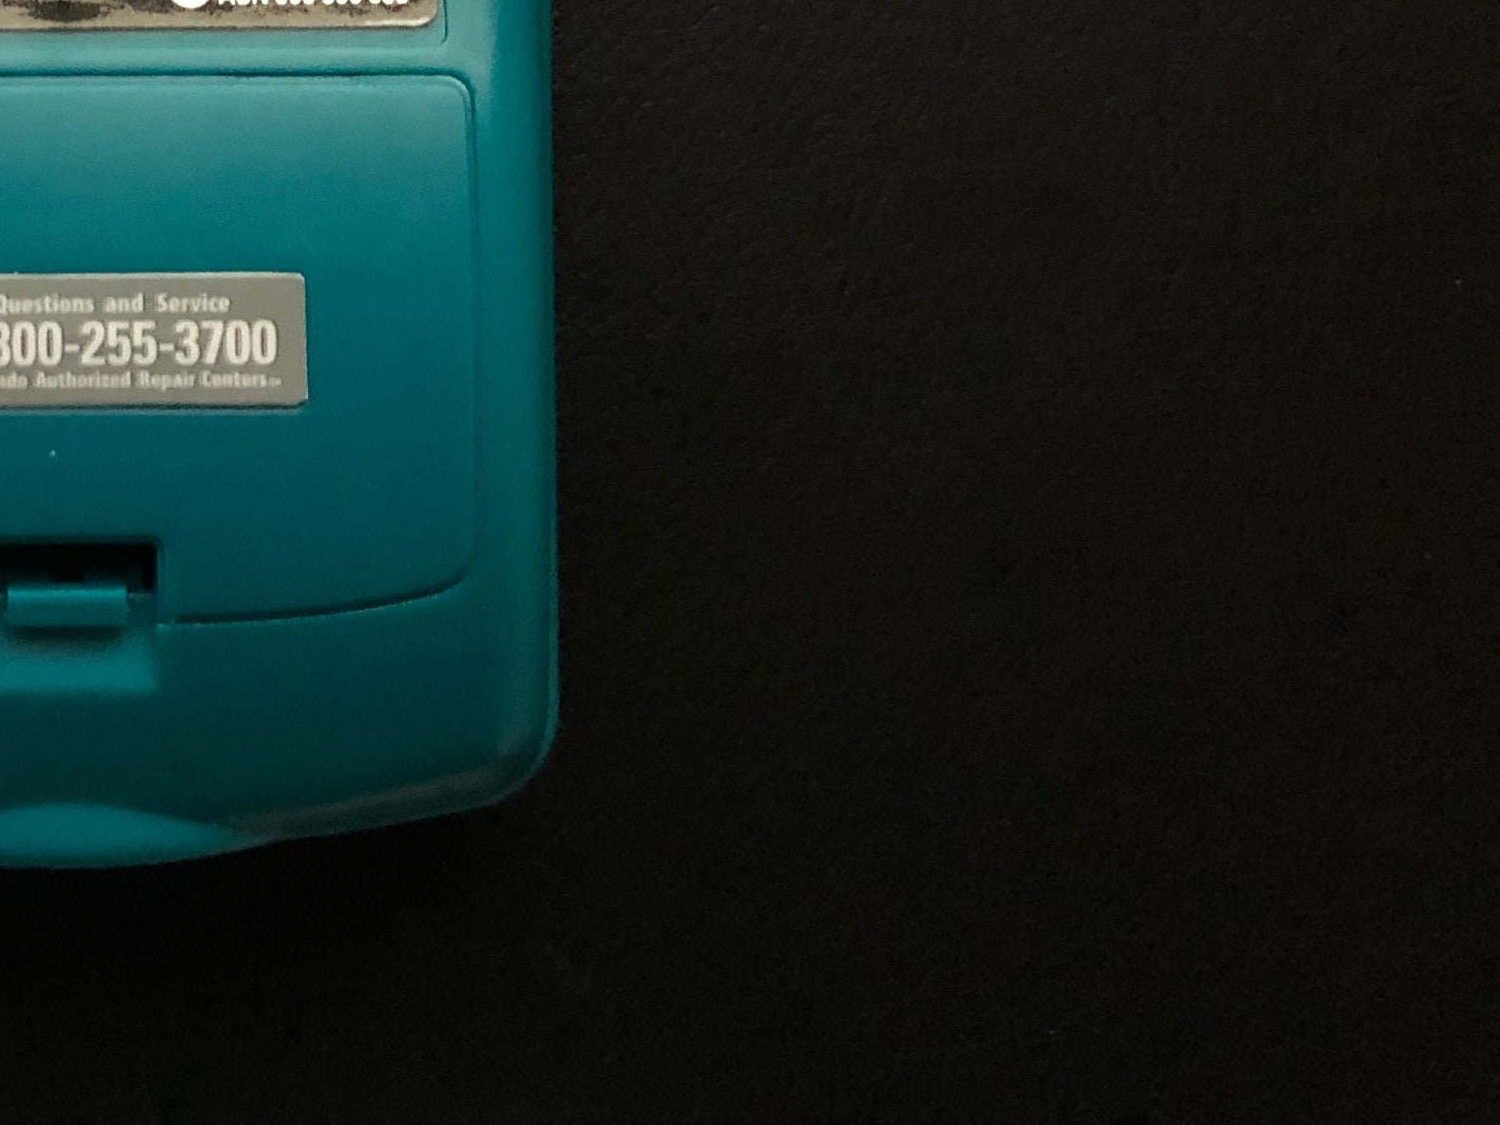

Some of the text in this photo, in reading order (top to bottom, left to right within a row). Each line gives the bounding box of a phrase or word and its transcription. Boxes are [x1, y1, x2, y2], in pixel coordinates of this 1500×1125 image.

[105, 294, 144, 313] and
[157, 293, 231, 313] Service
[35, 372, 131, 390] Authorized
[138, 371, 195, 391] Repair
